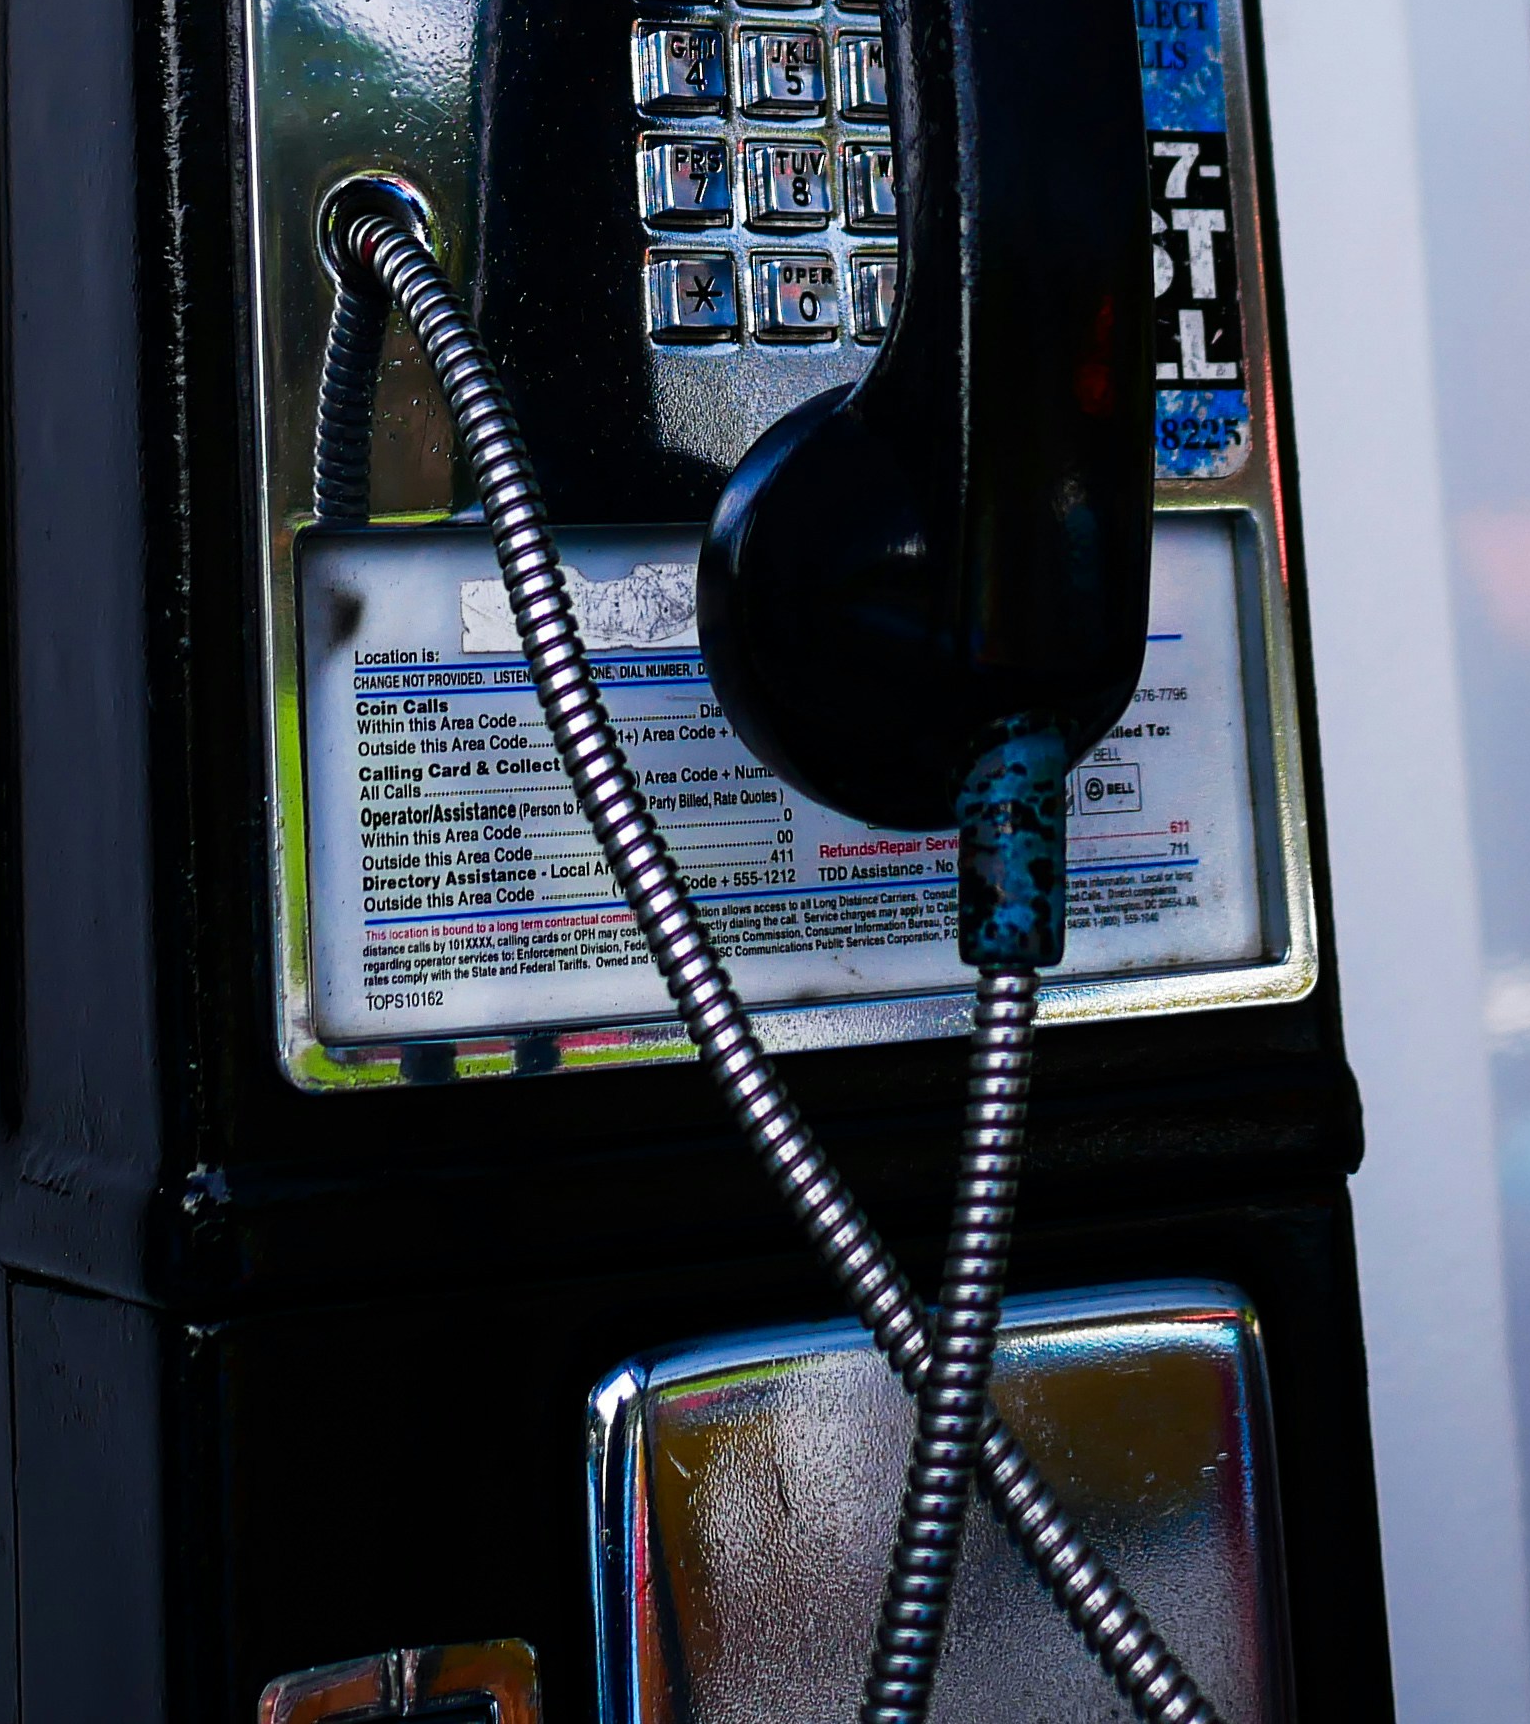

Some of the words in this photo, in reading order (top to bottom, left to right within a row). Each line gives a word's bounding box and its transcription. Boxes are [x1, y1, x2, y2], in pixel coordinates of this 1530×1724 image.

[671, 36, 715, 59] GHI
[772, 40, 817, 64] JKL
[686, 61, 706, 92] 4
[785, 66, 804, 95] 5
[675, 147, 723, 172] PRS
[777, 151, 826, 175] TUV
[690, 174, 708, 204] 7
[792, 177, 812, 206] 8
[783, 267, 833, 285] OPER
[355, 649, 417, 665] Location
[422, 648, 440, 663] is:
[353, 674, 399, 690] CHANGE
[403, 674, 424, 688] NOT
[428, 672, 485, 687] PROVIDED.
[494, 670, 531, 684] LISTEN
[619, 666, 644, 678] DIAL
[646, 663, 693, 677] NUMBER,
[356, 700, 397, 716] Coin
[403, 699, 448, 714] Calls
[357, 719, 405, 735] Within
[409, 717, 436, 732] this
[441, 715, 474, 731] Area
[1146, 723, 1170, 737] To:
[358, 741, 416, 756] Outside
[420, 739, 447, 753] this
[452, 738, 485, 752] Area
[643, 728, 675, 742] Area
[679, 725, 715, 740] Code
[359, 766, 423, 783] Calling
[428, 762, 471, 778] Card
[477, 762, 489, 776] &
[496, 758, 561, 775] Collect
[360, 785, 379, 801] All
[645, 770, 676, 785] Area
[681, 767, 718, 783] Code
[1106, 783, 1135, 795] BELL
[361, 802, 516, 829] Operator/Assistance
[519, 803, 560, 820] (Person
[564, 802, 574, 815] to
[650, 795, 676, 812] Party
[679, 792, 712, 808] Billed,
[714, 792, 737, 805] Rate
[741, 789, 777, 805] Quotes
[362, 833, 409, 848] Within
[413, 830, 441, 845] this
[445, 829, 479, 844] Area
[784, 808, 792, 821] 0
[362, 855, 420, 871] Outside
[425, 852, 452, 867] this
[457, 851, 490, 866] Area
[777, 830, 793, 844] 00
[819, 840, 921, 859] Refunds/Repair
[819, 866, 847, 881] TDD
[851, 862, 923, 879] Assistance
[935, 859, 953, 873] No
[1170, 842, 1190, 855] 711
[363, 875, 440, 892] Directory
[446, 868, 536, 886] Assistance
[551, 862, 590, 878] Local
[771, 850, 794, 863] 411
[364, 896, 422, 913] Outside
[427, 893, 454, 908] this
[458, 892, 492, 907] Area
[733, 869, 796, 886] 555-1212
[364, 973, 390, 987] rates
[392, 971, 428, 985] comply
[431, 969, 451, 982] with
[453, 968, 470, 980] the
[472, 966, 497, 978] State
[500, 965, 517, 976] and
[520, 961, 556, 974] Federal
[366, 990, 444, 1011] TOPS10162
